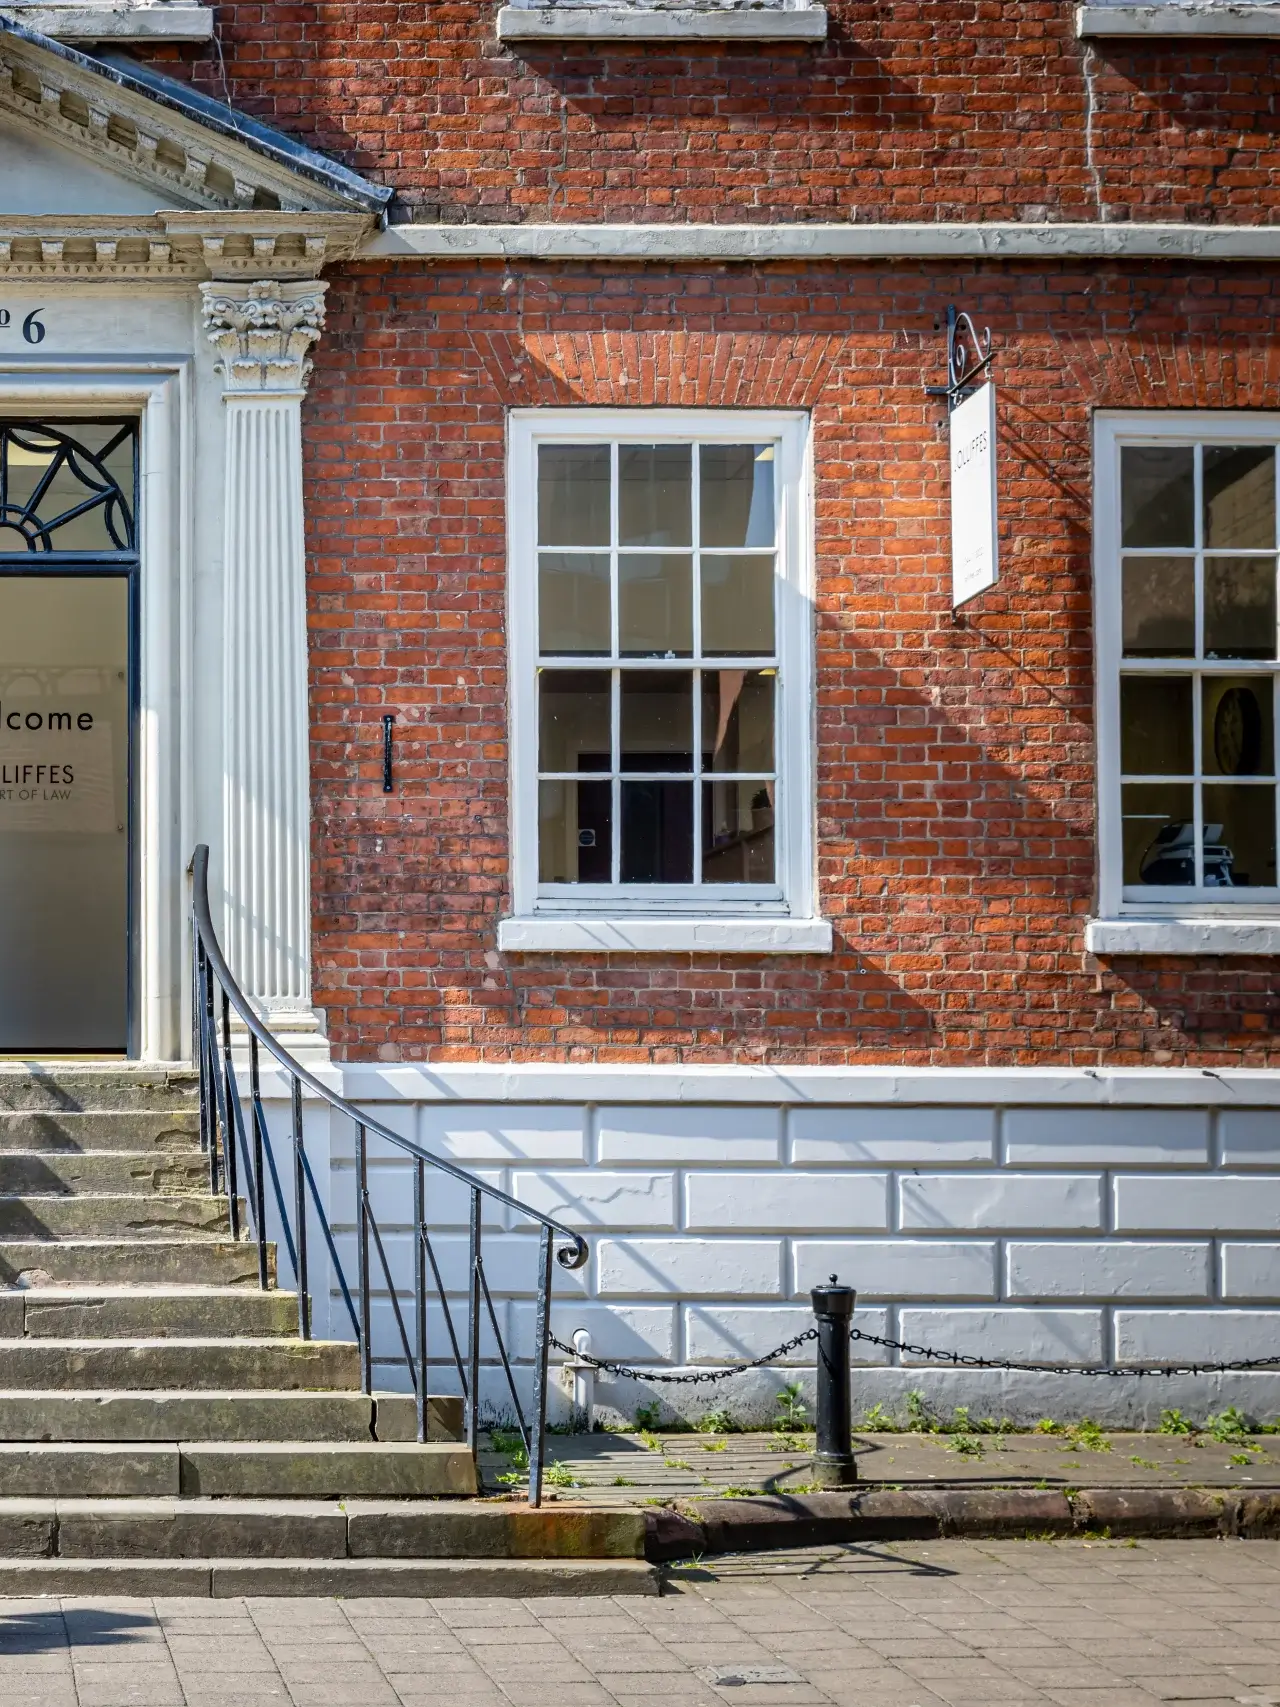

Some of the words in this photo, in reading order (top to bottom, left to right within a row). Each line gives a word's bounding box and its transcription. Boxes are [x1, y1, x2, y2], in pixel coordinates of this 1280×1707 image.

[22, 307, 45, 344] 6
[953, 430, 987, 473] OLLIFFES
[18, 789, 39, 801] OF
[43, 789, 72, 801] LAW
